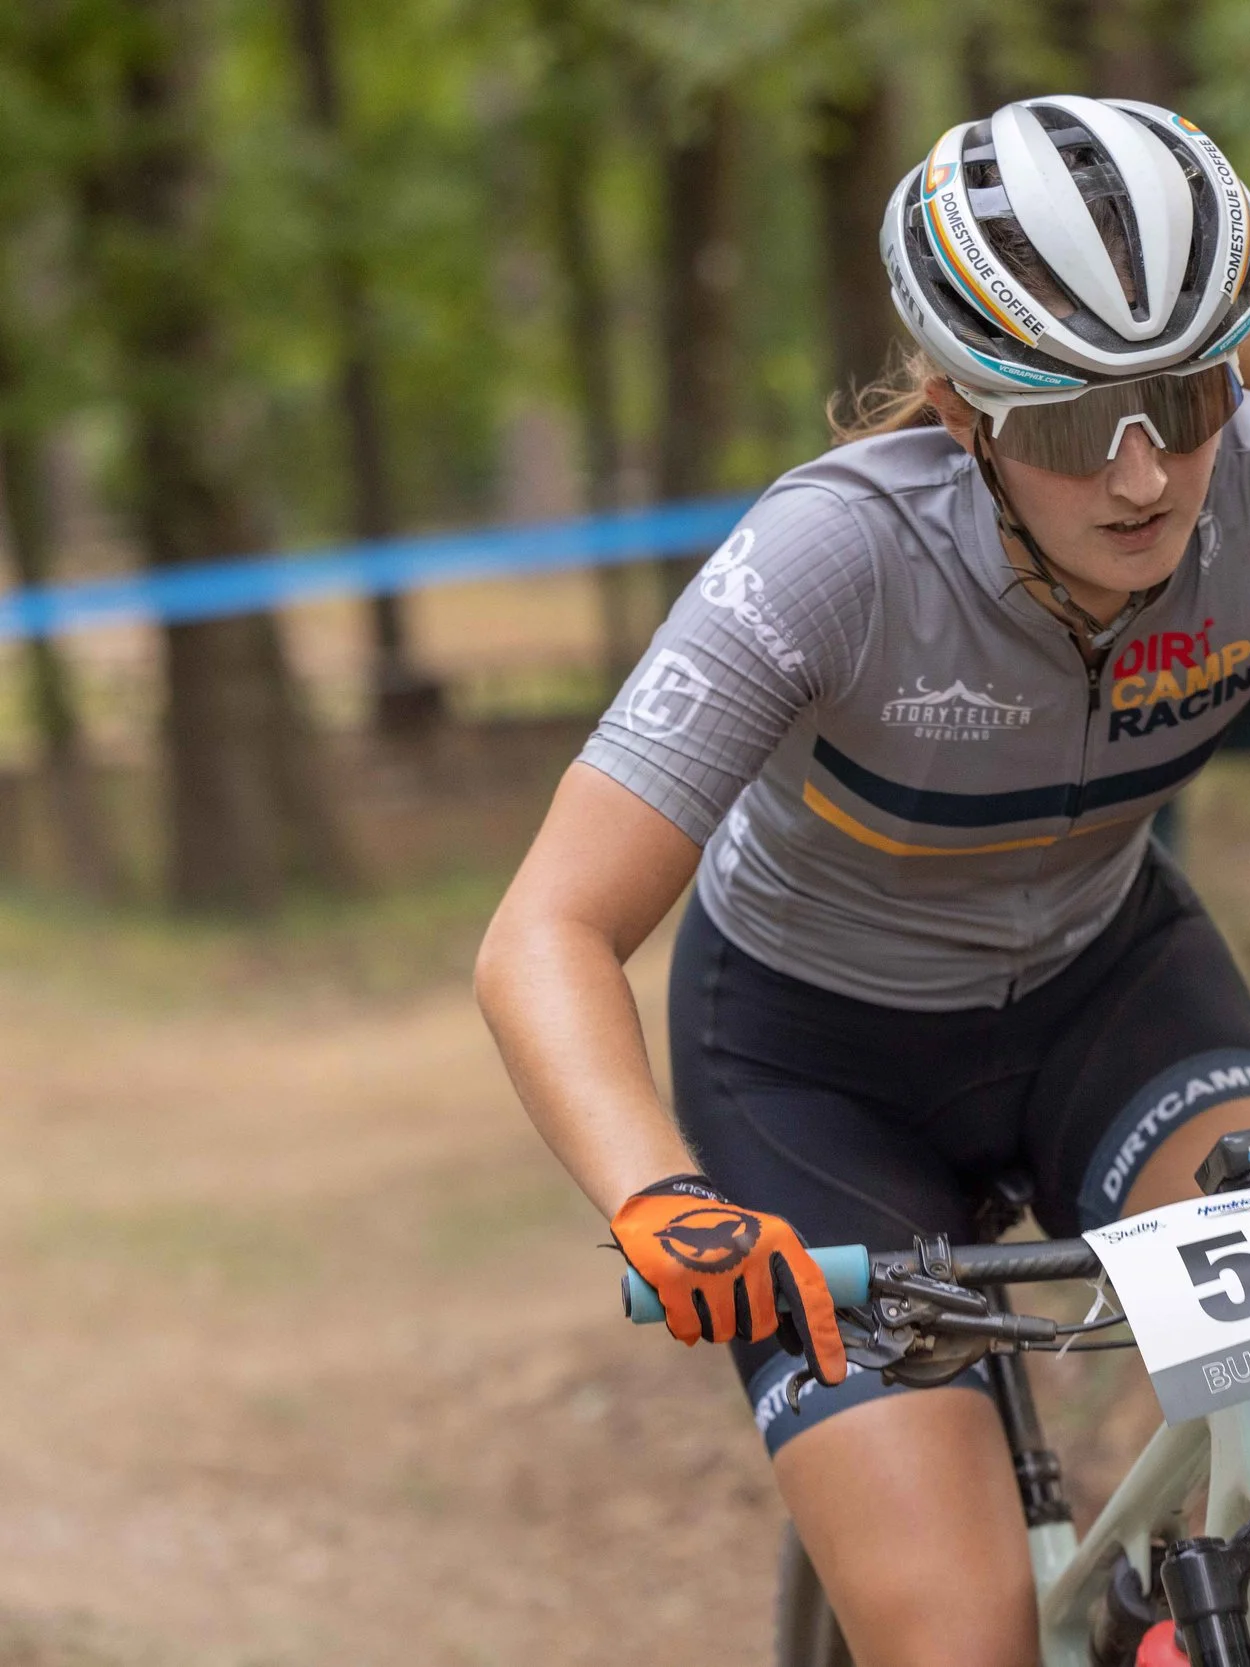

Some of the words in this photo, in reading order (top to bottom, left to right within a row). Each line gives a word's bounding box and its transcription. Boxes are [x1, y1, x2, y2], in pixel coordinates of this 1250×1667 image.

[1199, 139, 1233, 186] COFFEE
[941, 191, 995, 281] DOMESTIQUE
[990, 280, 1045, 336] COFFEE
[1224, 189, 1244, 294] DOMESTIQUE
[1113, 617, 1215, 681] DIRT
[880, 704, 1031, 726] STORYTELLER
